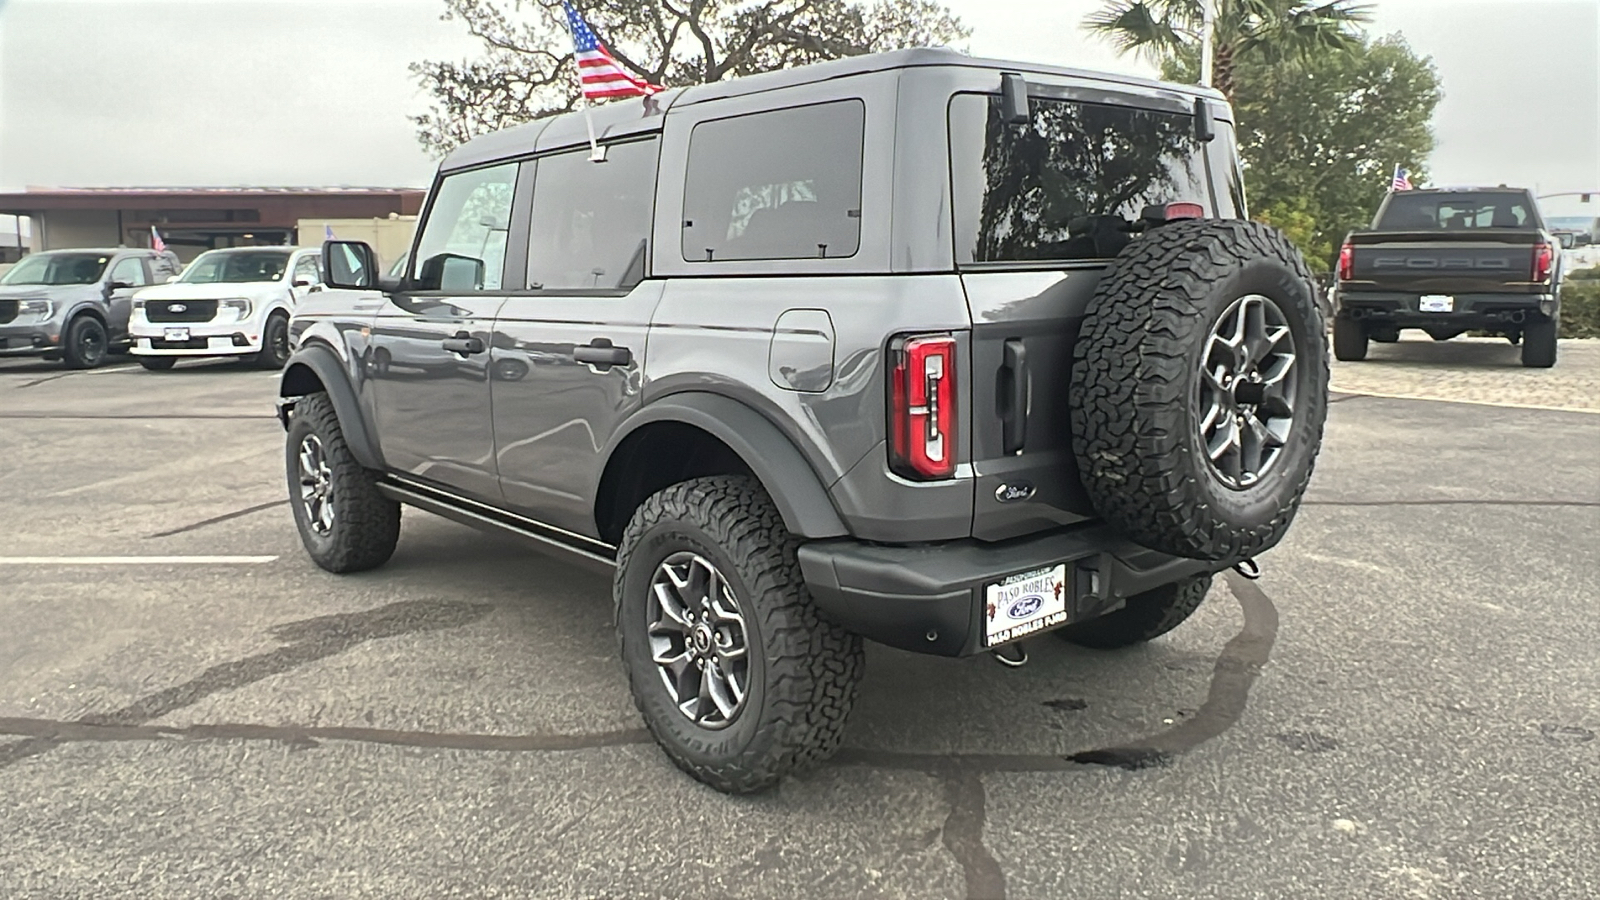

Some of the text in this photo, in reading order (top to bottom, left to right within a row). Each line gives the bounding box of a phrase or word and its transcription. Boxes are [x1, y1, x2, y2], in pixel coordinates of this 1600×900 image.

[1373, 257, 1510, 268] FORD
[998, 586, 1020, 609] PASO
[1022, 575, 1055, 594] ROBLES
[987, 629, 1011, 647] PASO
